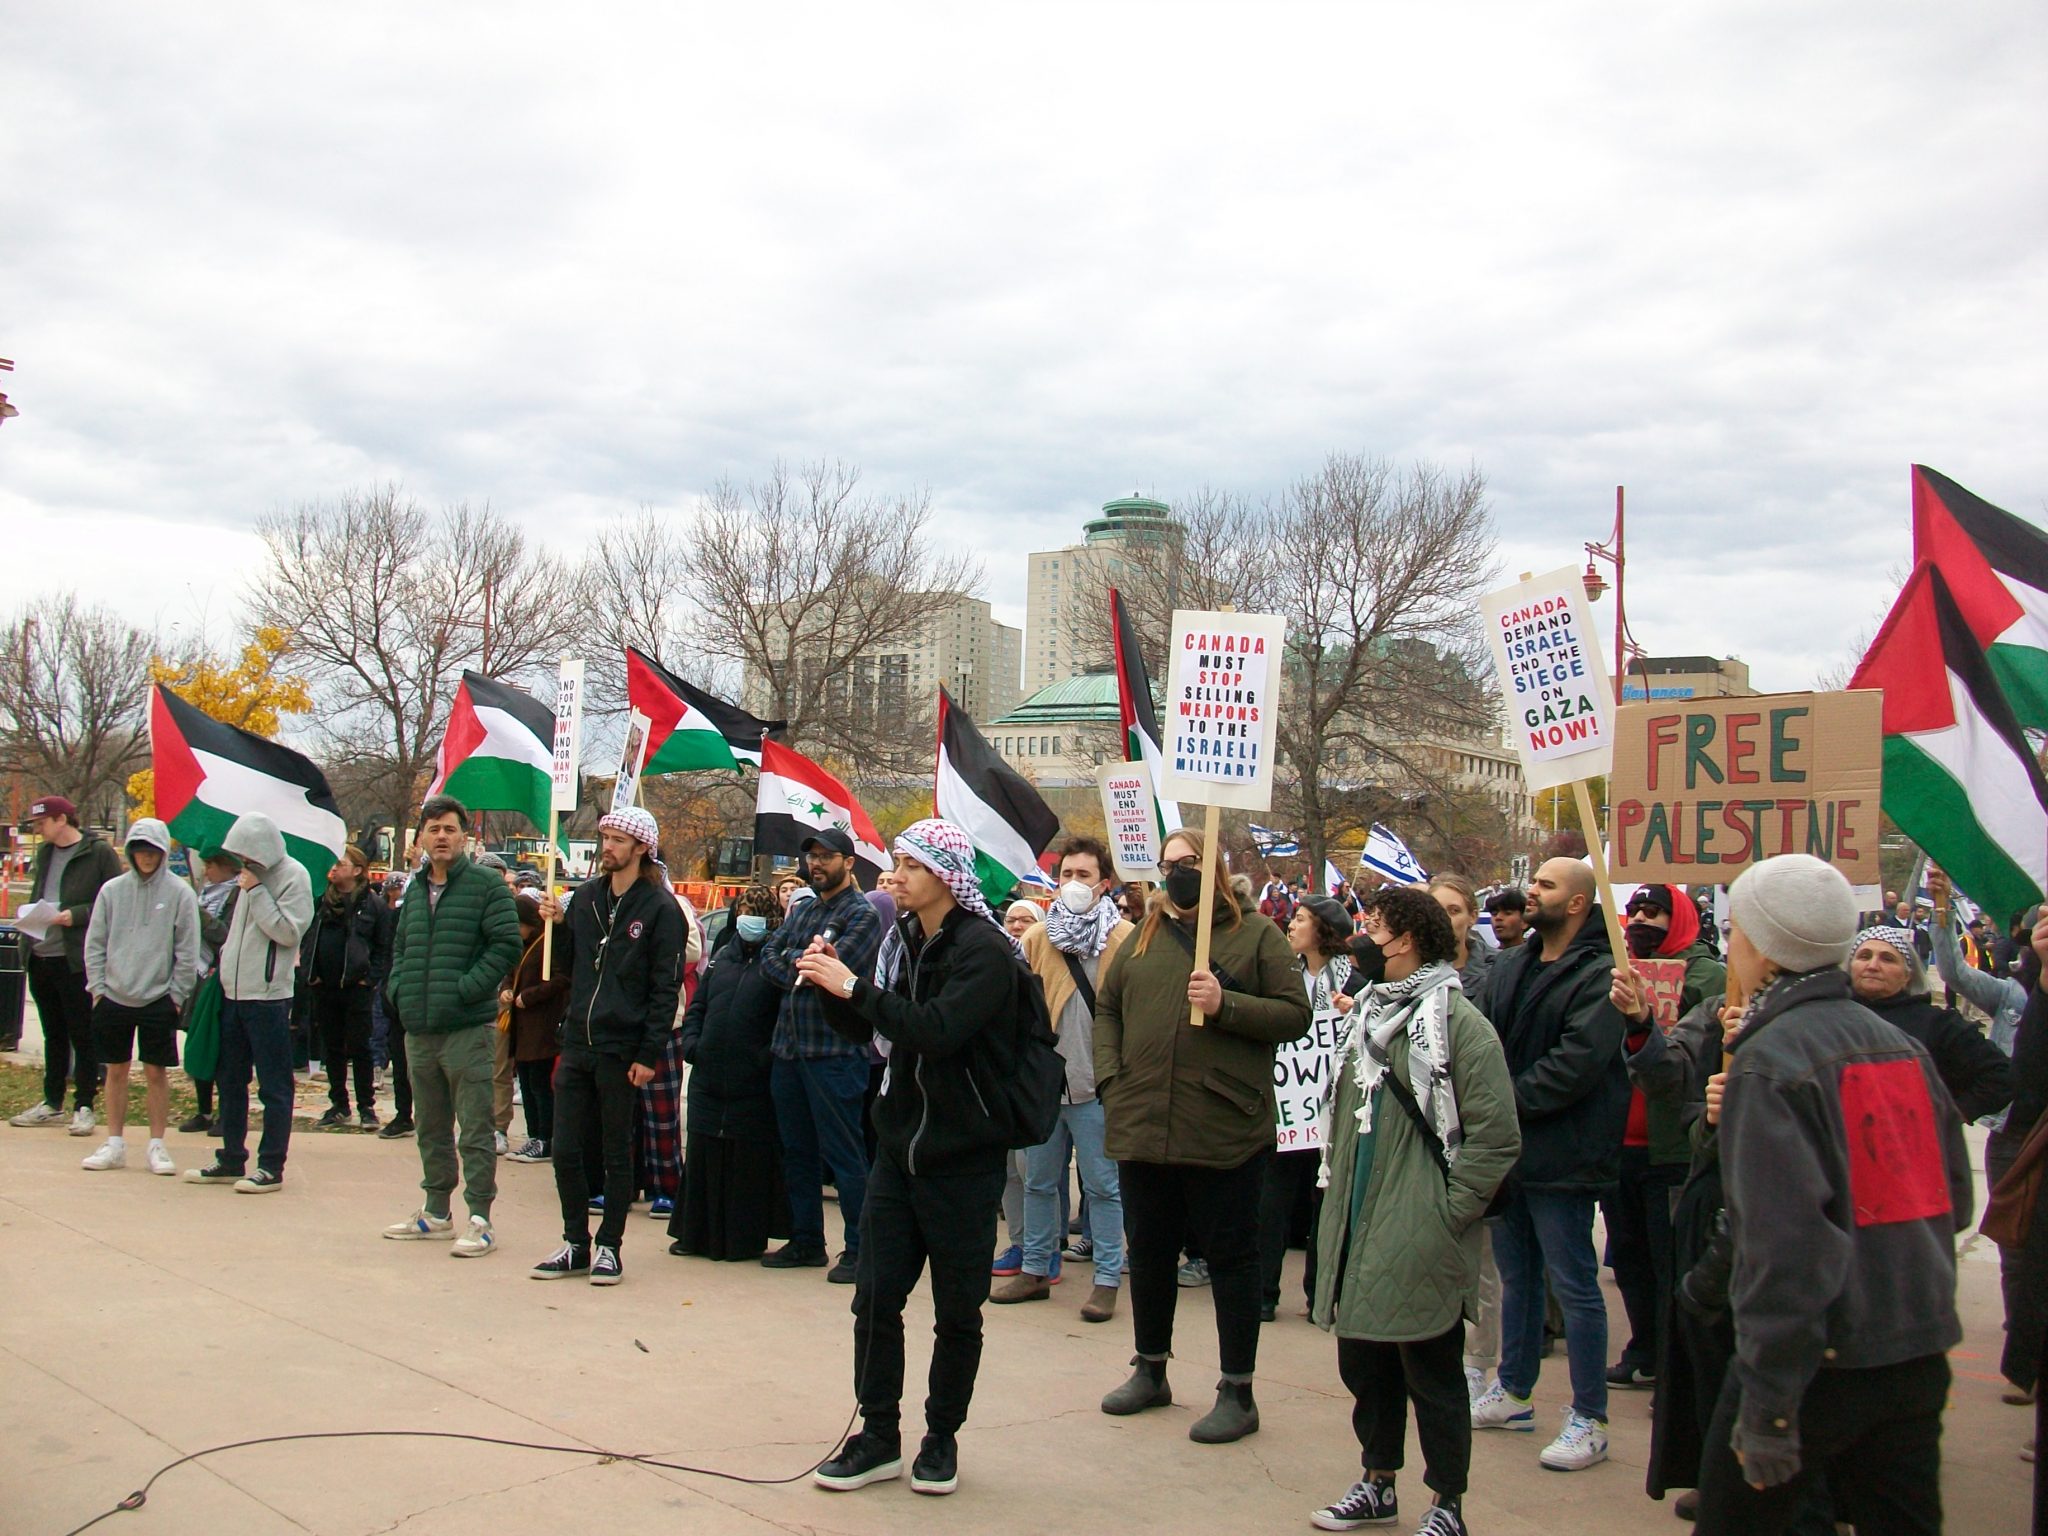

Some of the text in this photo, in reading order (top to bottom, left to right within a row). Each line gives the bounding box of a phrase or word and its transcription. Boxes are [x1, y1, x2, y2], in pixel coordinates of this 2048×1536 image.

[1501, 596, 1568, 628] CANADA
[1504, 612, 1572, 644] DEMAND
[1185, 633, 1265, 654] CANADA
[1507, 628, 1577, 661] ISRAEL
[1199, 655, 1245, 671] MUST
[1511, 645, 1580, 675] END THE
[1199, 671, 1242, 687] STOP
[1515, 659, 1584, 693] SIEGE
[1185, 686, 1255, 704] SELLING
[1541, 686, 1563, 702] ON
[557, 704, 573, 718] ZA
[1180, 702, 1259, 722] WEAPONS
[1524, 694, 1594, 728] GAZA
[1189, 719, 1247, 738] TO THE
[1529, 716, 1599, 751] NOW!
[556, 749, 570, 760] FOR
[1177, 736, 1257, 760] ISRAELI
[1647, 707, 1809, 791] FREE
[1176, 758, 1256, 778] MILITARY
[1109, 780, 1141, 790] CANADA
[1114, 790, 1137, 799] MUST
[1113, 809, 1145, 817] MILITARY
[1118, 800, 1136, 809] END
[1122, 824, 1140, 832] AND
[1617, 799, 1861, 867] PALESTINE
[1119, 833, 1147, 842] TRADE
[1123, 843, 1145, 852] WITH
[1121, 853, 1152, 862] ISRAEL
